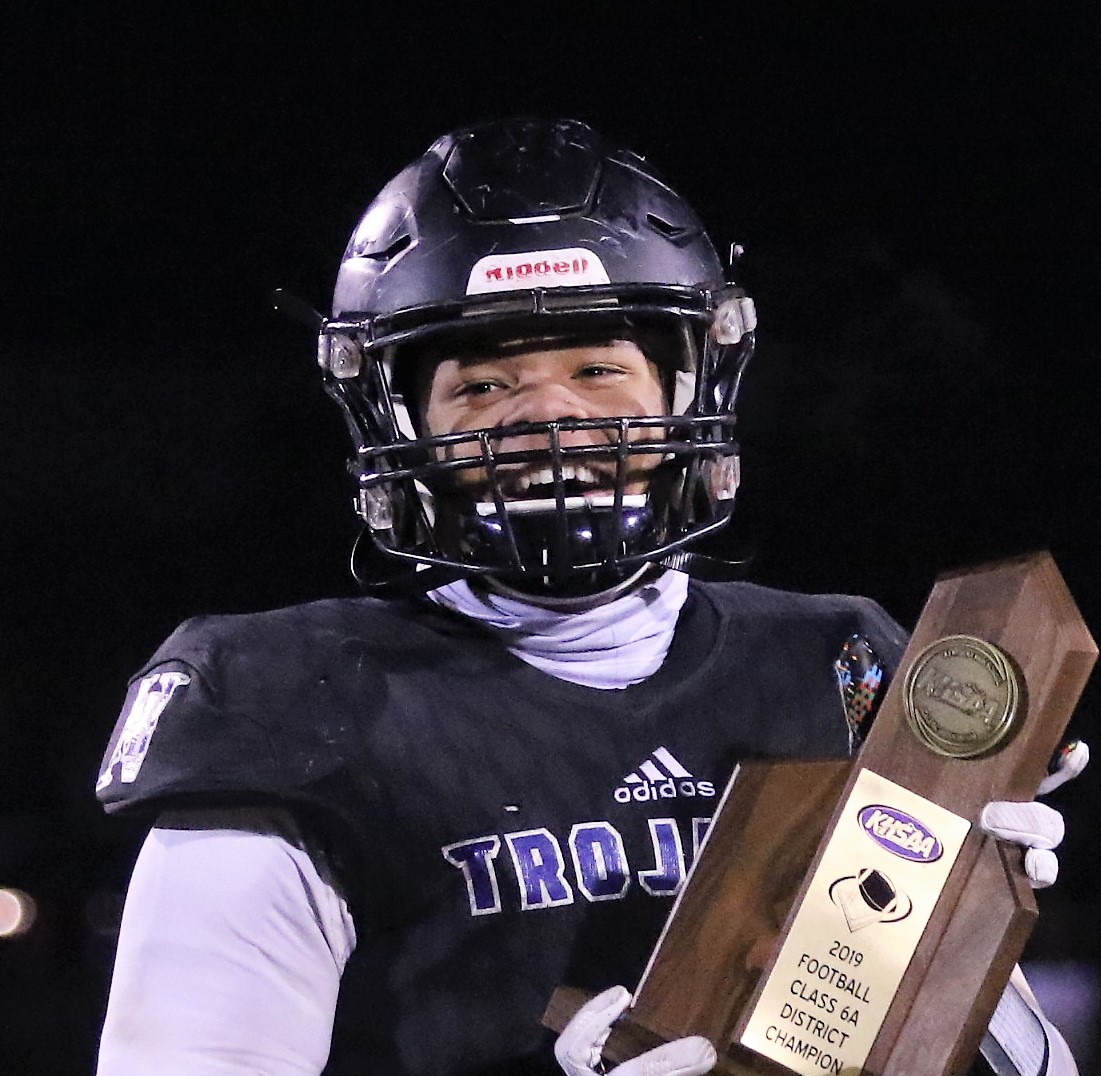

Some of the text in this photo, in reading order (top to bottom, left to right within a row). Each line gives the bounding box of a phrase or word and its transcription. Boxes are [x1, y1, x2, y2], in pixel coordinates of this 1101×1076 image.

[485, 256, 589, 283] Riddell
[613, 778, 716, 804] adidas
[864, 809, 937, 859] KHSAA
[441, 817, 715, 916] TROJ
[828, 940, 864, 967] 2019
[797, 953, 871, 1004] FOOTBALL
[780, 1002, 850, 1049] DISTRICT
[790, 979, 860, 1028] CLASS 6A
[765, 1025, 844, 1076] CHAMPION
